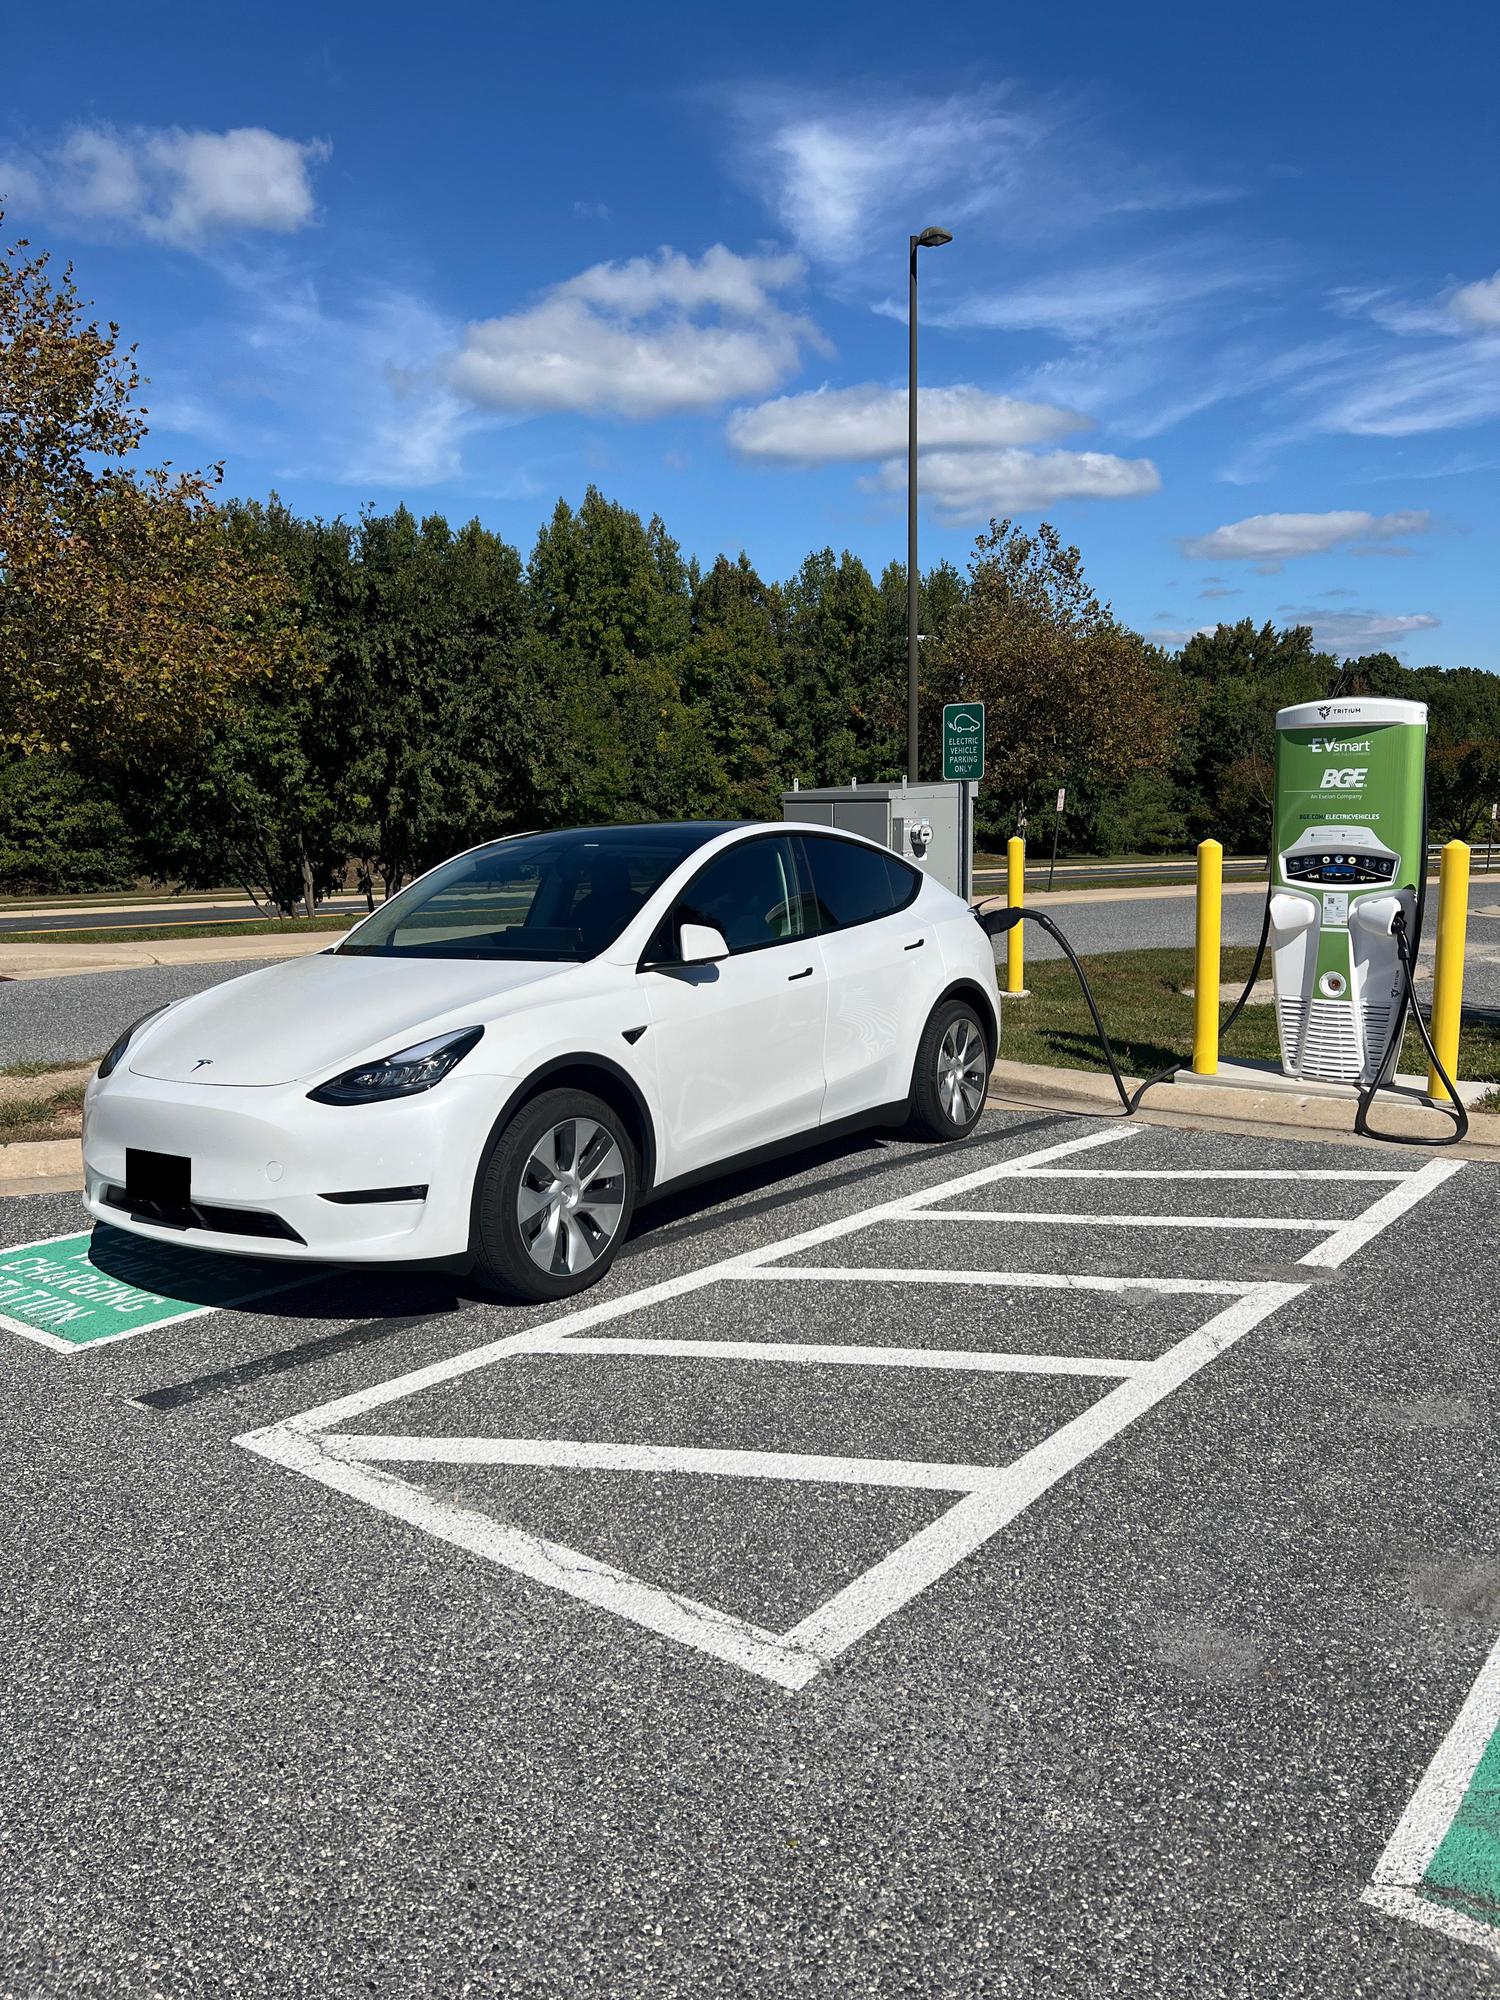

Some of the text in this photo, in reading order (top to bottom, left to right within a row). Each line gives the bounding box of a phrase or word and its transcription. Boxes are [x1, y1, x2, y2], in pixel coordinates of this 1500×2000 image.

[950, 746, 977, 754] VEHICLE
[954, 765, 972, 773] ONLY
[1320, 768, 1367, 788] BGE
[0, 1257, 166, 1313] CHARGING
[0, 1275, 96, 1326] TATION
